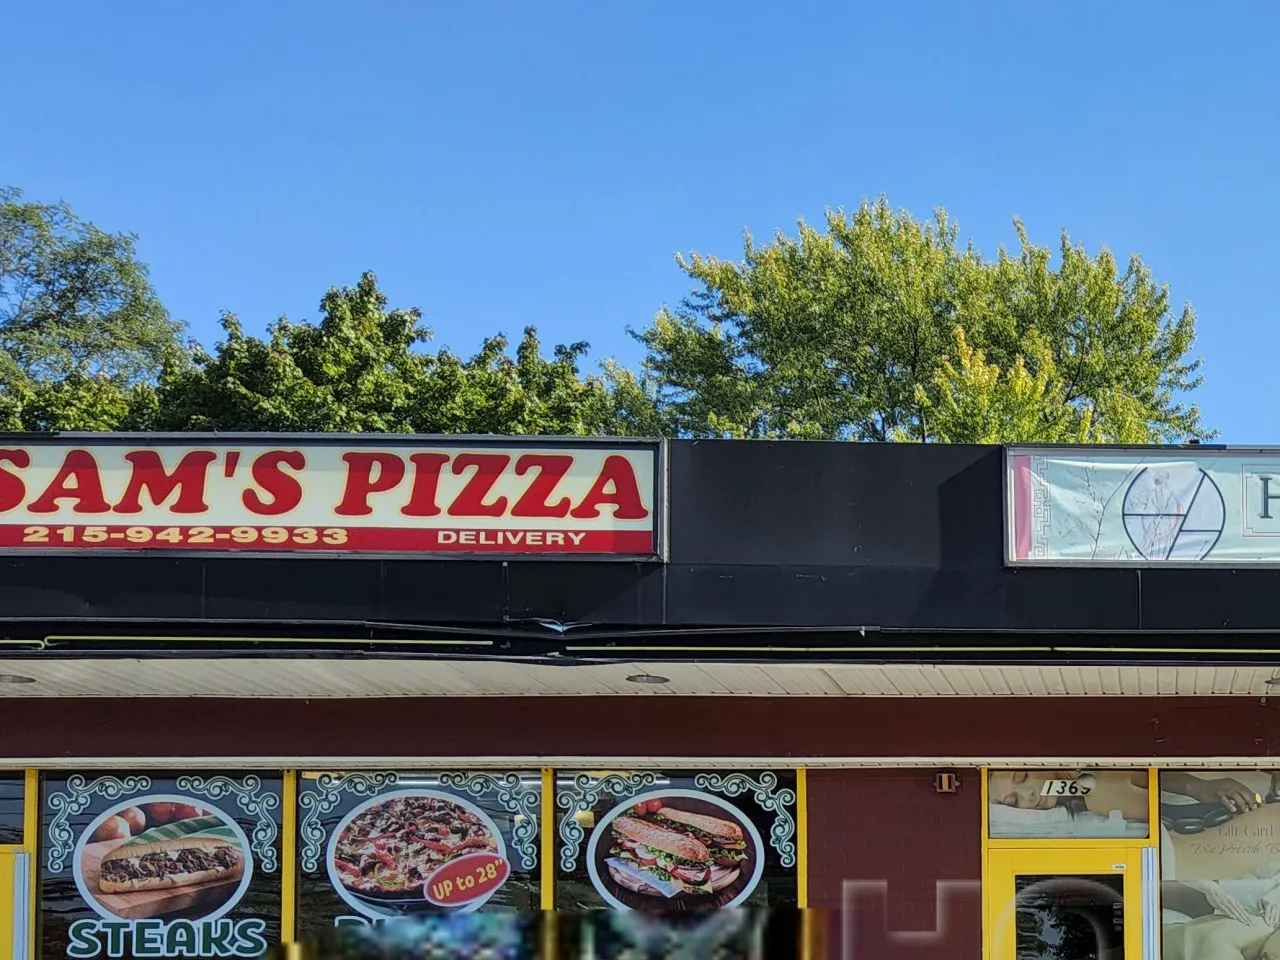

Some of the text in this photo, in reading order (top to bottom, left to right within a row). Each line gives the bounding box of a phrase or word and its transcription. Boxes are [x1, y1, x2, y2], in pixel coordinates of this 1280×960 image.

[0, 447, 651, 520] SAM'S PIZZA
[23, 525, 348, 545] 215-942-9933
[437, 529, 587, 546] DELIVERY
[456, 874, 475, 891] to
[66, 918, 267, 958] STEAKS
